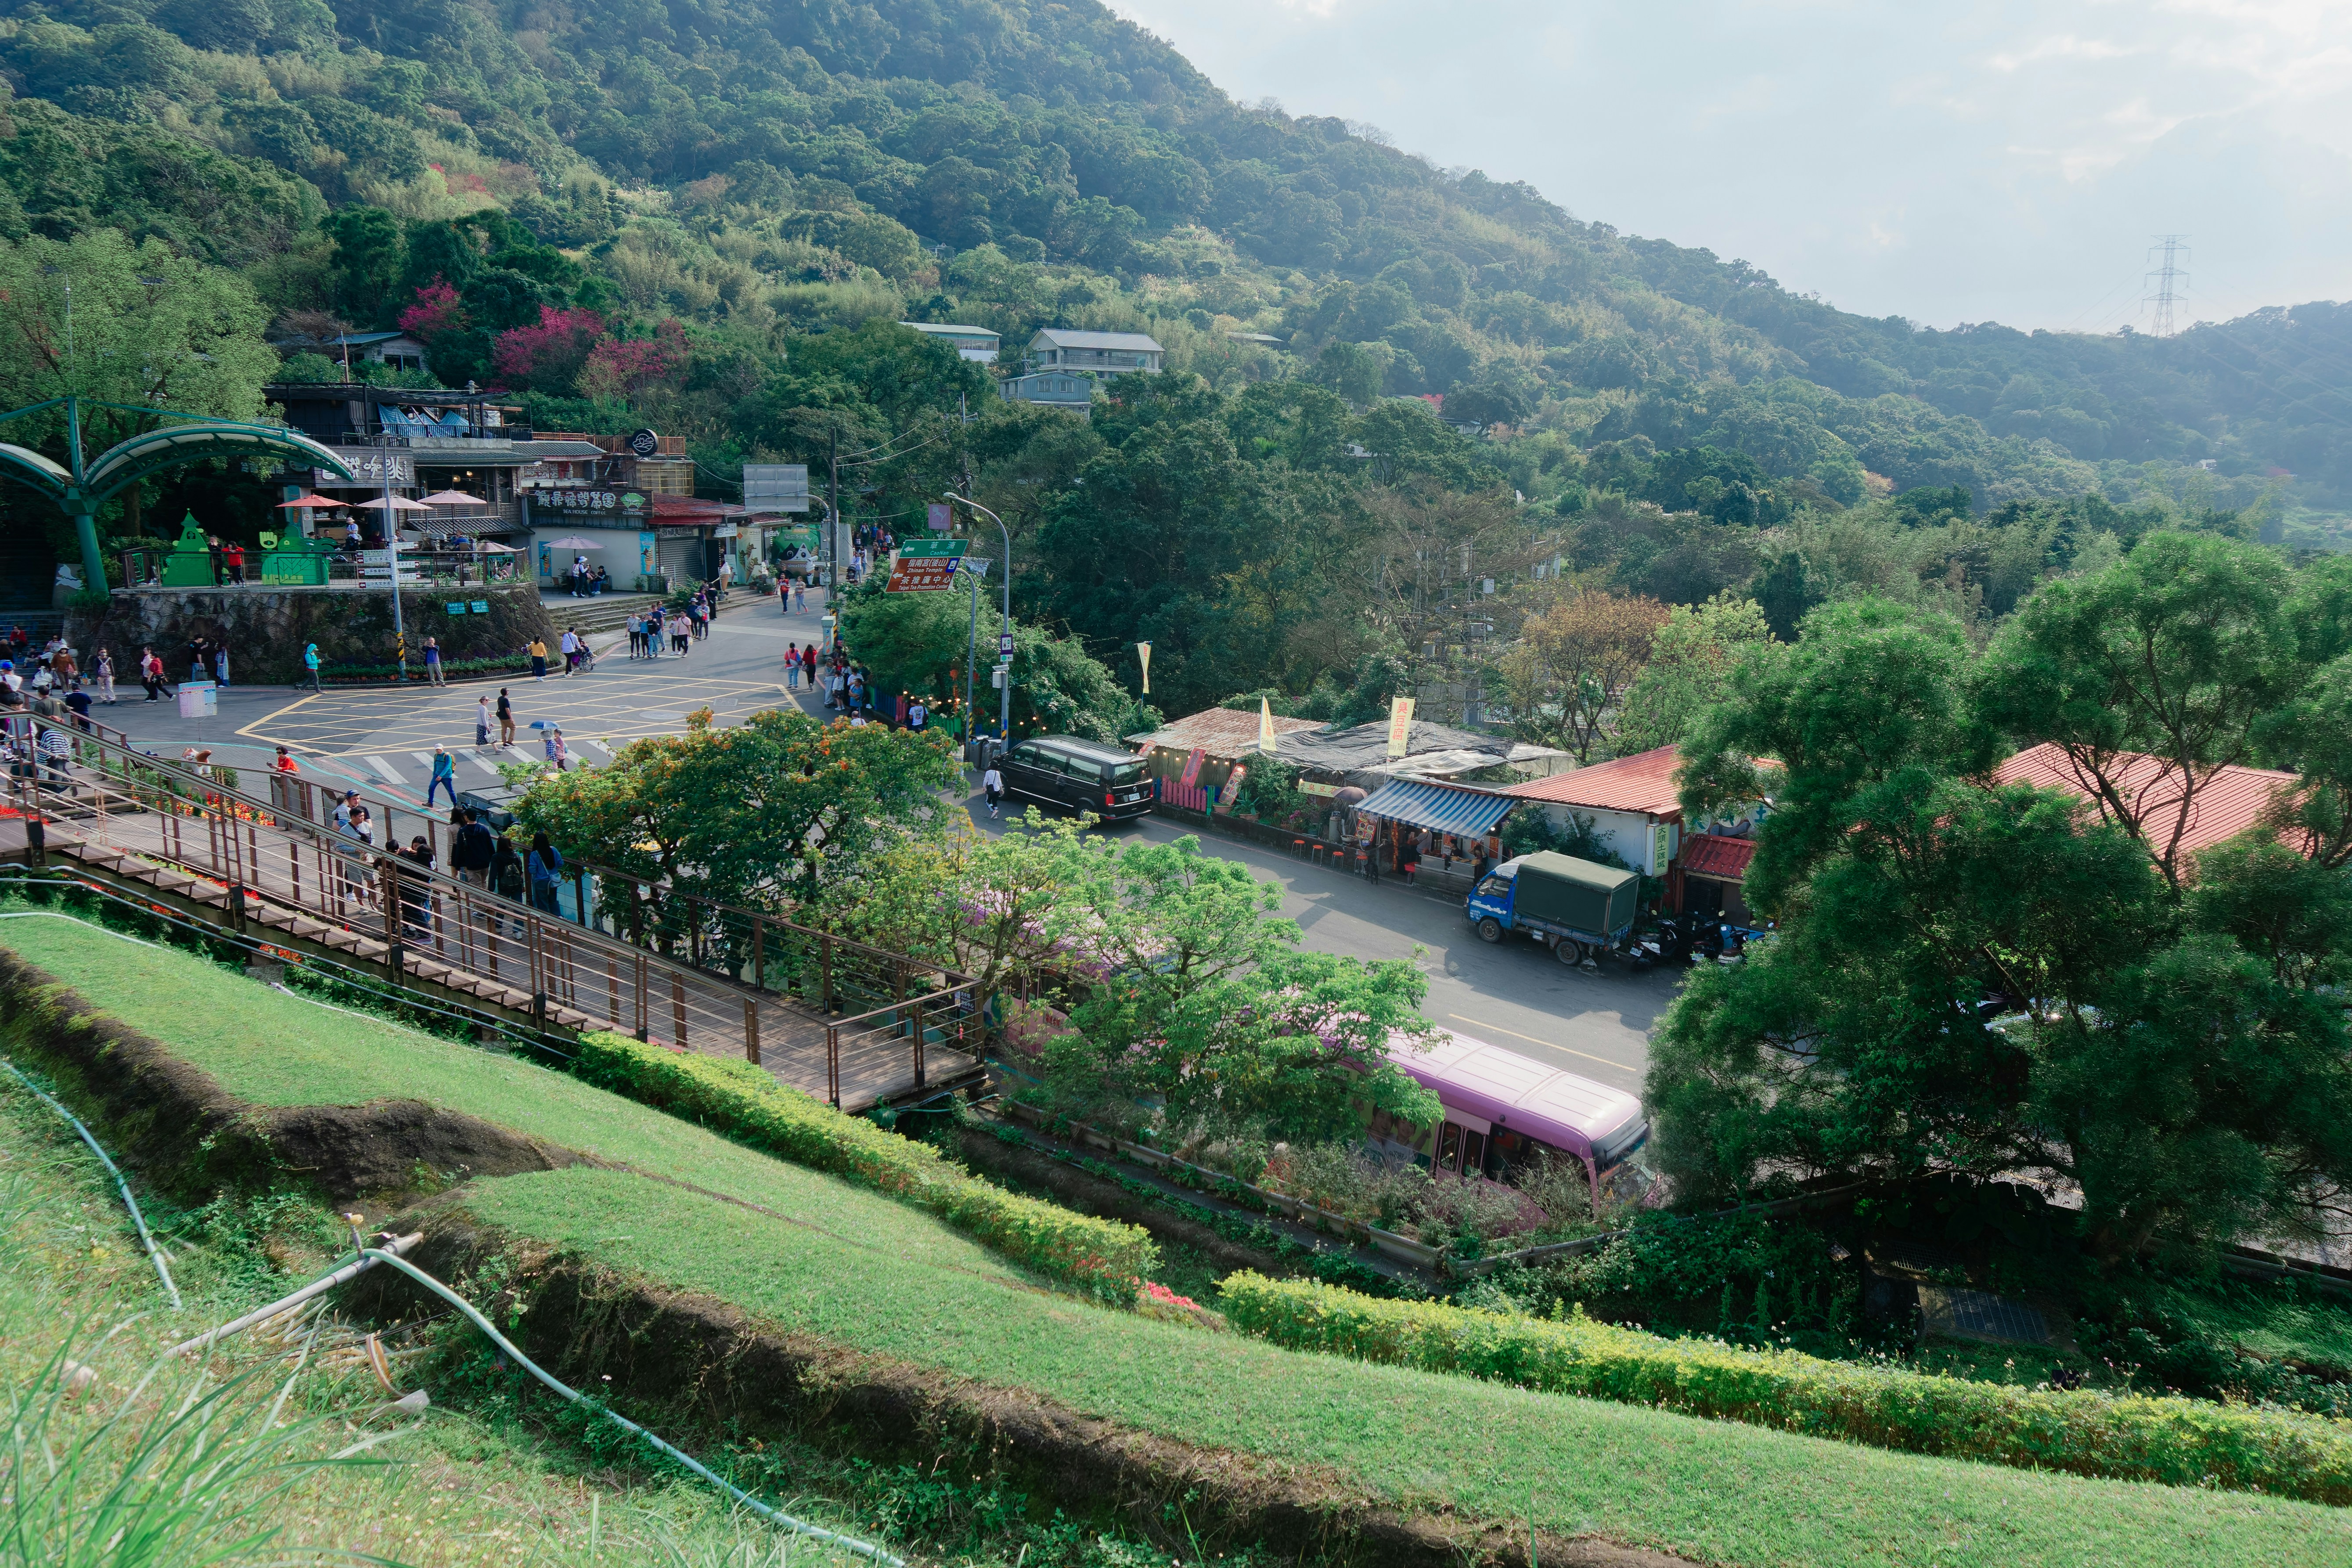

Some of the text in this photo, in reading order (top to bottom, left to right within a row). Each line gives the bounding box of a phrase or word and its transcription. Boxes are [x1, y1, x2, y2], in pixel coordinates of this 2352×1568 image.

[322, 455, 404, 480] 咖啡
[929, 541, 956, 549] 草湳
[907, 558, 948, 567] 指南宮(後山)
[900, 575, 950, 584] 茶推廣中心
[1392, 701, 1408, 740] 臭豆腐
[1657, 827, 1666, 868] 大頭土雞城
